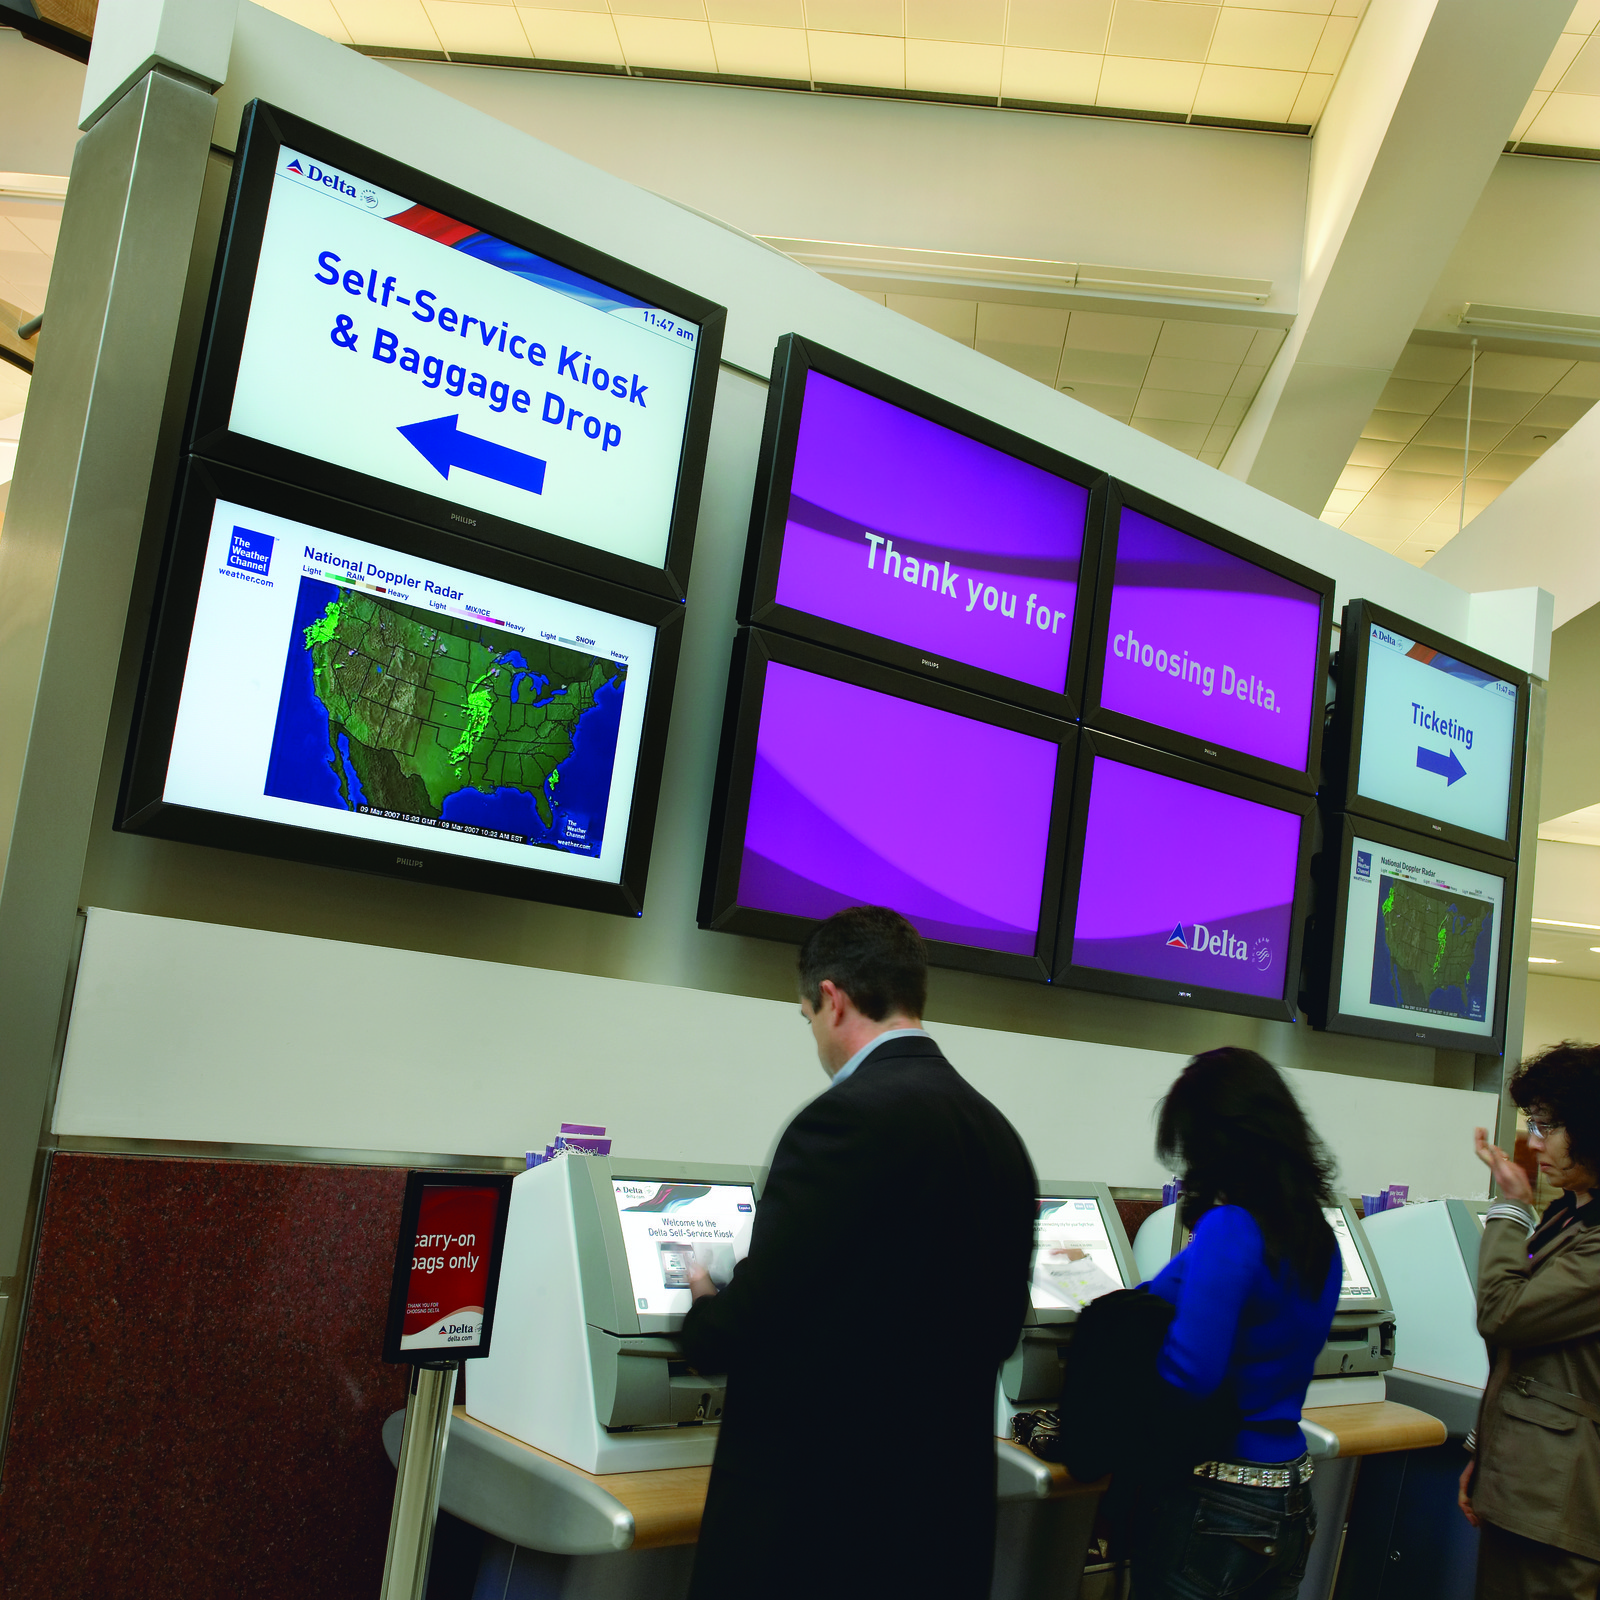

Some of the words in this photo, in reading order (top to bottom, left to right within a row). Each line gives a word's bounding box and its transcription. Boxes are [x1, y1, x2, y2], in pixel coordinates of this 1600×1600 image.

[307, 164, 356, 198] Delta
[314, 251, 547, 366] Self-Service
[558, 345, 648, 407] Kiosk
[644, 311, 674, 332] 11:47
[676, 327, 694, 341] am
[330, 314, 359, 352] &
[372, 328, 531, 413] Baggage
[542, 392, 622, 451] Drop
[451, 513, 477, 527] PHILIPS
[234, 536, 251, 548] The
[232, 545, 269, 562] Weather
[230, 555, 267, 572] Channel
[302, 564, 322, 576] Light
[219, 568, 274, 588] weather.com
[304, 546, 363, 573] National
[367, 563, 421, 589] Doppler
[424, 580, 464, 600] Radar
[346, 571, 365, 582] RAIN
[864, 531, 959, 599] Thank
[965, 578, 1017, 619] you
[1026, 593, 1066, 634] for
[388, 588, 409, 600] Heavy
[429, 600, 447, 610] Light
[465, 604, 491, 616] MIX/ICE
[505, 621, 526, 633] Heavy
[540, 630, 557, 641] Light
[575, 635, 596, 646] SNOW
[1378, 630, 1396, 646] Delta
[610, 650, 629, 661] Heavy
[1113, 630, 1215, 697] choosing
[1221, 664, 1281, 714] Delta.
[1411, 702, 1473, 750] Ticketing
[396, 857, 423, 868] PHILIPS
[1380, 856, 1402, 868] National
[1401, 862, 1421, 874] Doppler
[1421, 867, 1436, 878] Radar
[1191, 923, 1248, 961] Delta
[623, 1186, 643, 1194] Delta
[661, 1217, 695, 1227] Welcome
[696, 1219, 704, 1227] to
[705, 1219, 717, 1227] the
[648, 1227, 668, 1236] Delta
[668, 1228, 713, 1238] Self-Service
[713, 1229, 735, 1239] Kiosk
[449, 1251, 480, 1273] only
[448, 1323, 473, 1334] Delta
